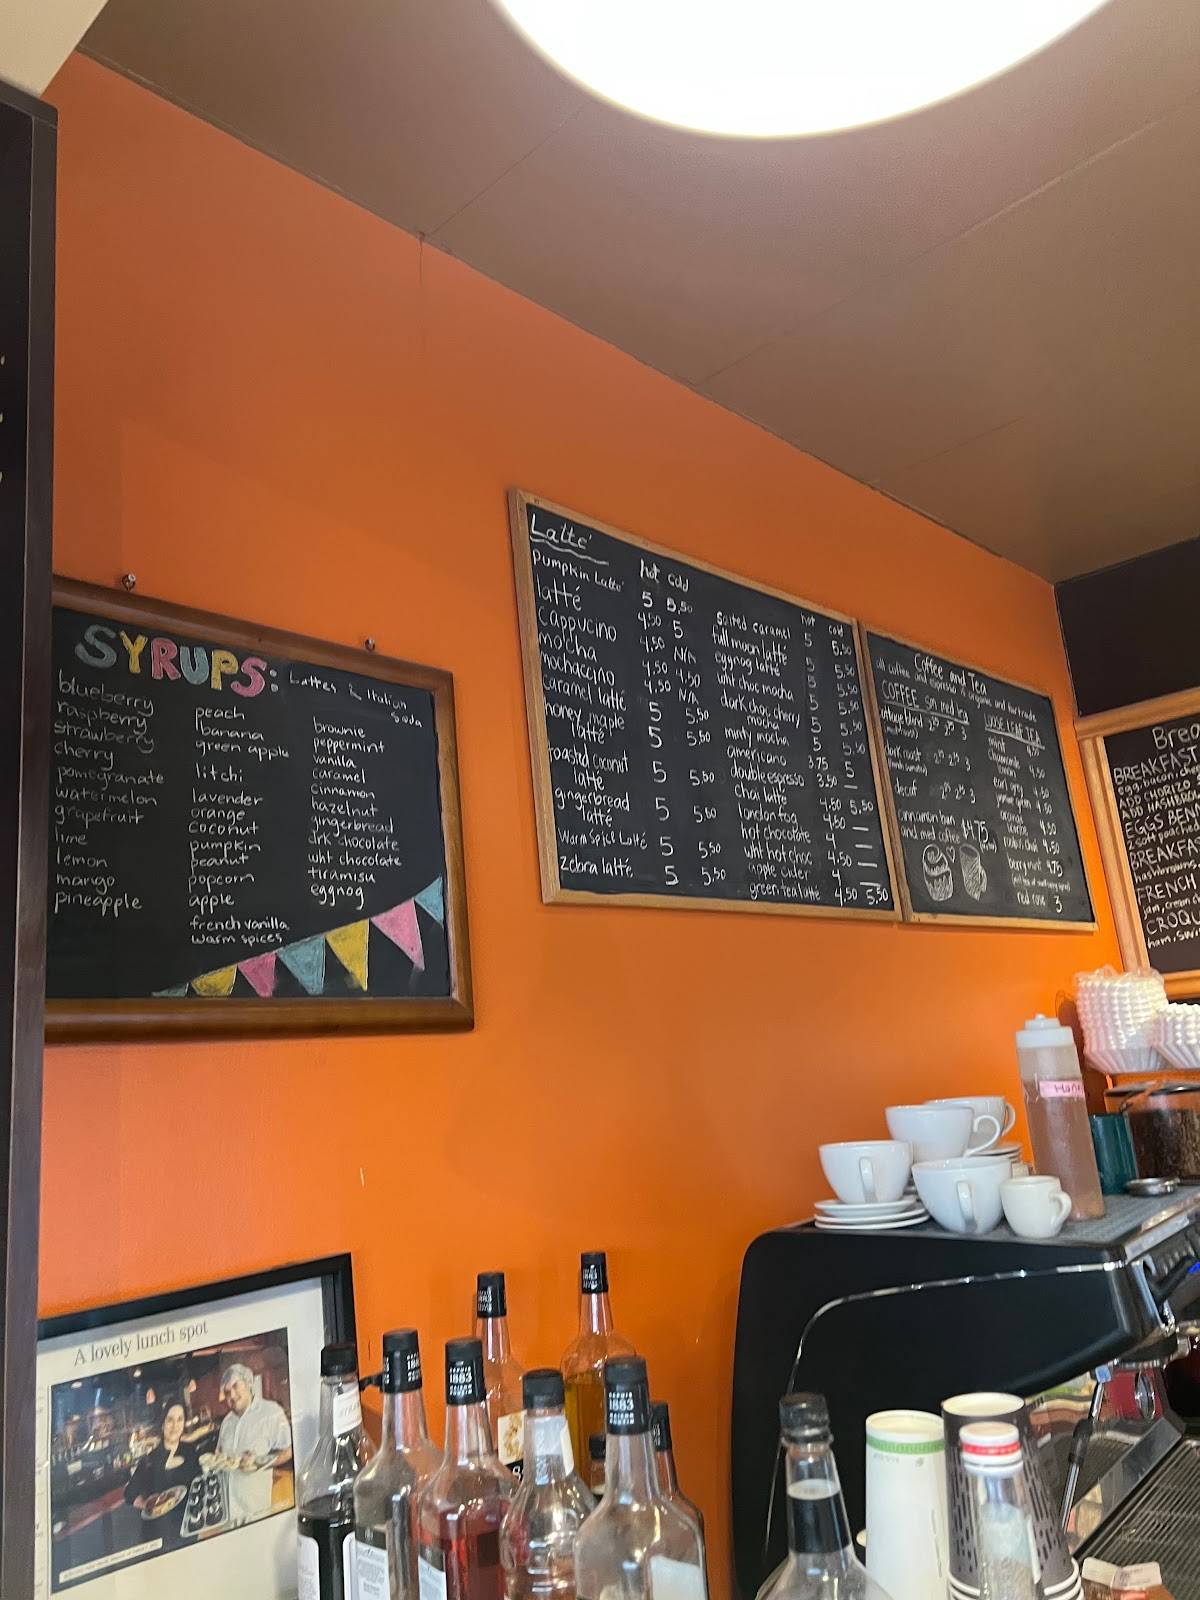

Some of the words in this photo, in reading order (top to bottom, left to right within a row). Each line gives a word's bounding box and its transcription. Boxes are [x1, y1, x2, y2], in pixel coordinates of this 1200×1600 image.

[642, 591, 653, 608] 5
[673, 619, 684, 639] 5
[752, 622, 791, 640] caramel
[804, 632, 812, 648] 5
[639, 635, 666, 653] 4.50
[673, 646, 697, 665] N/A
[731, 637, 760, 656] moon
[75, 624, 279, 698] SYRUPS:
[538, 631, 597, 661] mocha
[642, 660, 669, 677] 4.50
[675, 668, 701, 688] 4.50
[58, 669, 154, 716] blueberry
[543, 675, 592, 704] caramel
[649, 701, 662, 722] 5
[685, 707, 709, 725] 5.50
[644, 679, 671, 694] 4.50
[678, 687, 700, 705] N/A
[762, 683, 794, 701] mocha
[809, 694, 819, 711] 5
[881, 679, 920, 708] COFFEE
[57, 701, 148, 736] raspberry
[195, 706, 245, 731] peach
[720, 688, 747, 712] dark
[811, 716, 822, 733] 5
[201, 720, 265, 742] banana
[313, 716, 366, 738] brownie
[544, 697, 581, 729] honey
[589, 713, 625, 736] maple
[649, 726, 663, 749] 5
[686, 730, 711, 747] 5.50
[747, 714, 780, 731] mocha
[53, 720, 155, 754] strawberry
[313, 737, 385, 754] peppermint
[724, 726, 752, 748] minty
[812, 736, 822, 752] 5
[54, 740, 114, 771] cherry
[195, 740, 241, 757] green
[248, 746, 290, 762] apple
[312, 754, 357, 769] vanilla
[195, 763, 243, 783] litchi
[547, 743, 590, 769] toasted
[593, 750, 628, 774] coconut
[652, 761, 667, 784] 5
[689, 769, 715, 786] 5.50
[730, 758, 766, 781] double
[816, 773, 838, 788] 3.50
[808, 755, 829, 771] 3.75
[844, 761, 855, 778] 5
[1113, 745, 1198, 785] BREAKFAST
[57, 766, 165, 791] pomegranate
[312, 769, 367, 784] caramel
[55, 787, 158, 806] watermelon
[192, 787, 264, 806] lavender
[1144, 780, 1191, 801] CHORIZO
[190, 807, 246, 825] orange
[311, 797, 378, 817] hazelnut
[554, 787, 630, 812] gingerbread
[655, 797, 670, 822] 5
[693, 805, 717, 823] 5.50
[819, 797, 842, 812] 4.50
[850, 799, 873, 815] 5.50
[54, 804, 145, 830] grapefruit
[311, 816, 395, 837] gingerbread
[779, 805, 798, 831] fog
[823, 813, 846, 830] 4.50
[1125, 813, 1163, 839] EGGS
[54, 826, 88, 845] lime
[338, 835, 400, 852] chocolate
[740, 821, 760, 840] hot
[763, 827, 811, 844] chocolate
[825, 833, 836, 849] 4
[56, 847, 108, 868] lemon
[189, 840, 261, 858] pumpkin
[660, 836, 674, 857] 5
[698, 841, 721, 859] 5.50
[766, 841, 787, 859] hot
[828, 850, 852, 868] 4.50
[190, 853, 249, 876] peanut
[339, 853, 402, 867] chocolate
[56, 873, 115, 895] mango
[188, 872, 255, 893] popcorn
[307, 867, 376, 883] tiramisu
[664, 865, 679, 886] 5
[701, 866, 726, 886] 5.50
[831, 869, 842, 886] 4
[311, 883, 365, 910] eggnog
[749, 883, 779, 900] green
[781, 880, 797, 898] tea
[866, 888, 889, 905] 5.50
[1136, 873, 1197, 905] FRENCH
[54, 891, 143, 918] pineapple
[188, 894, 235, 914] apple
[190, 915, 241, 933] french
[244, 916, 288, 932] vanilla
[191, 934, 236, 944] warm
[241, 932, 282, 947] spices
[74, 1348, 87, 1367] A
[91, 1337, 132, 1361] lovely
[136, 1327, 175, 1351] lunch
[179, 1321, 208, 1343] spot
[609, 1399, 634, 1411] 1883
